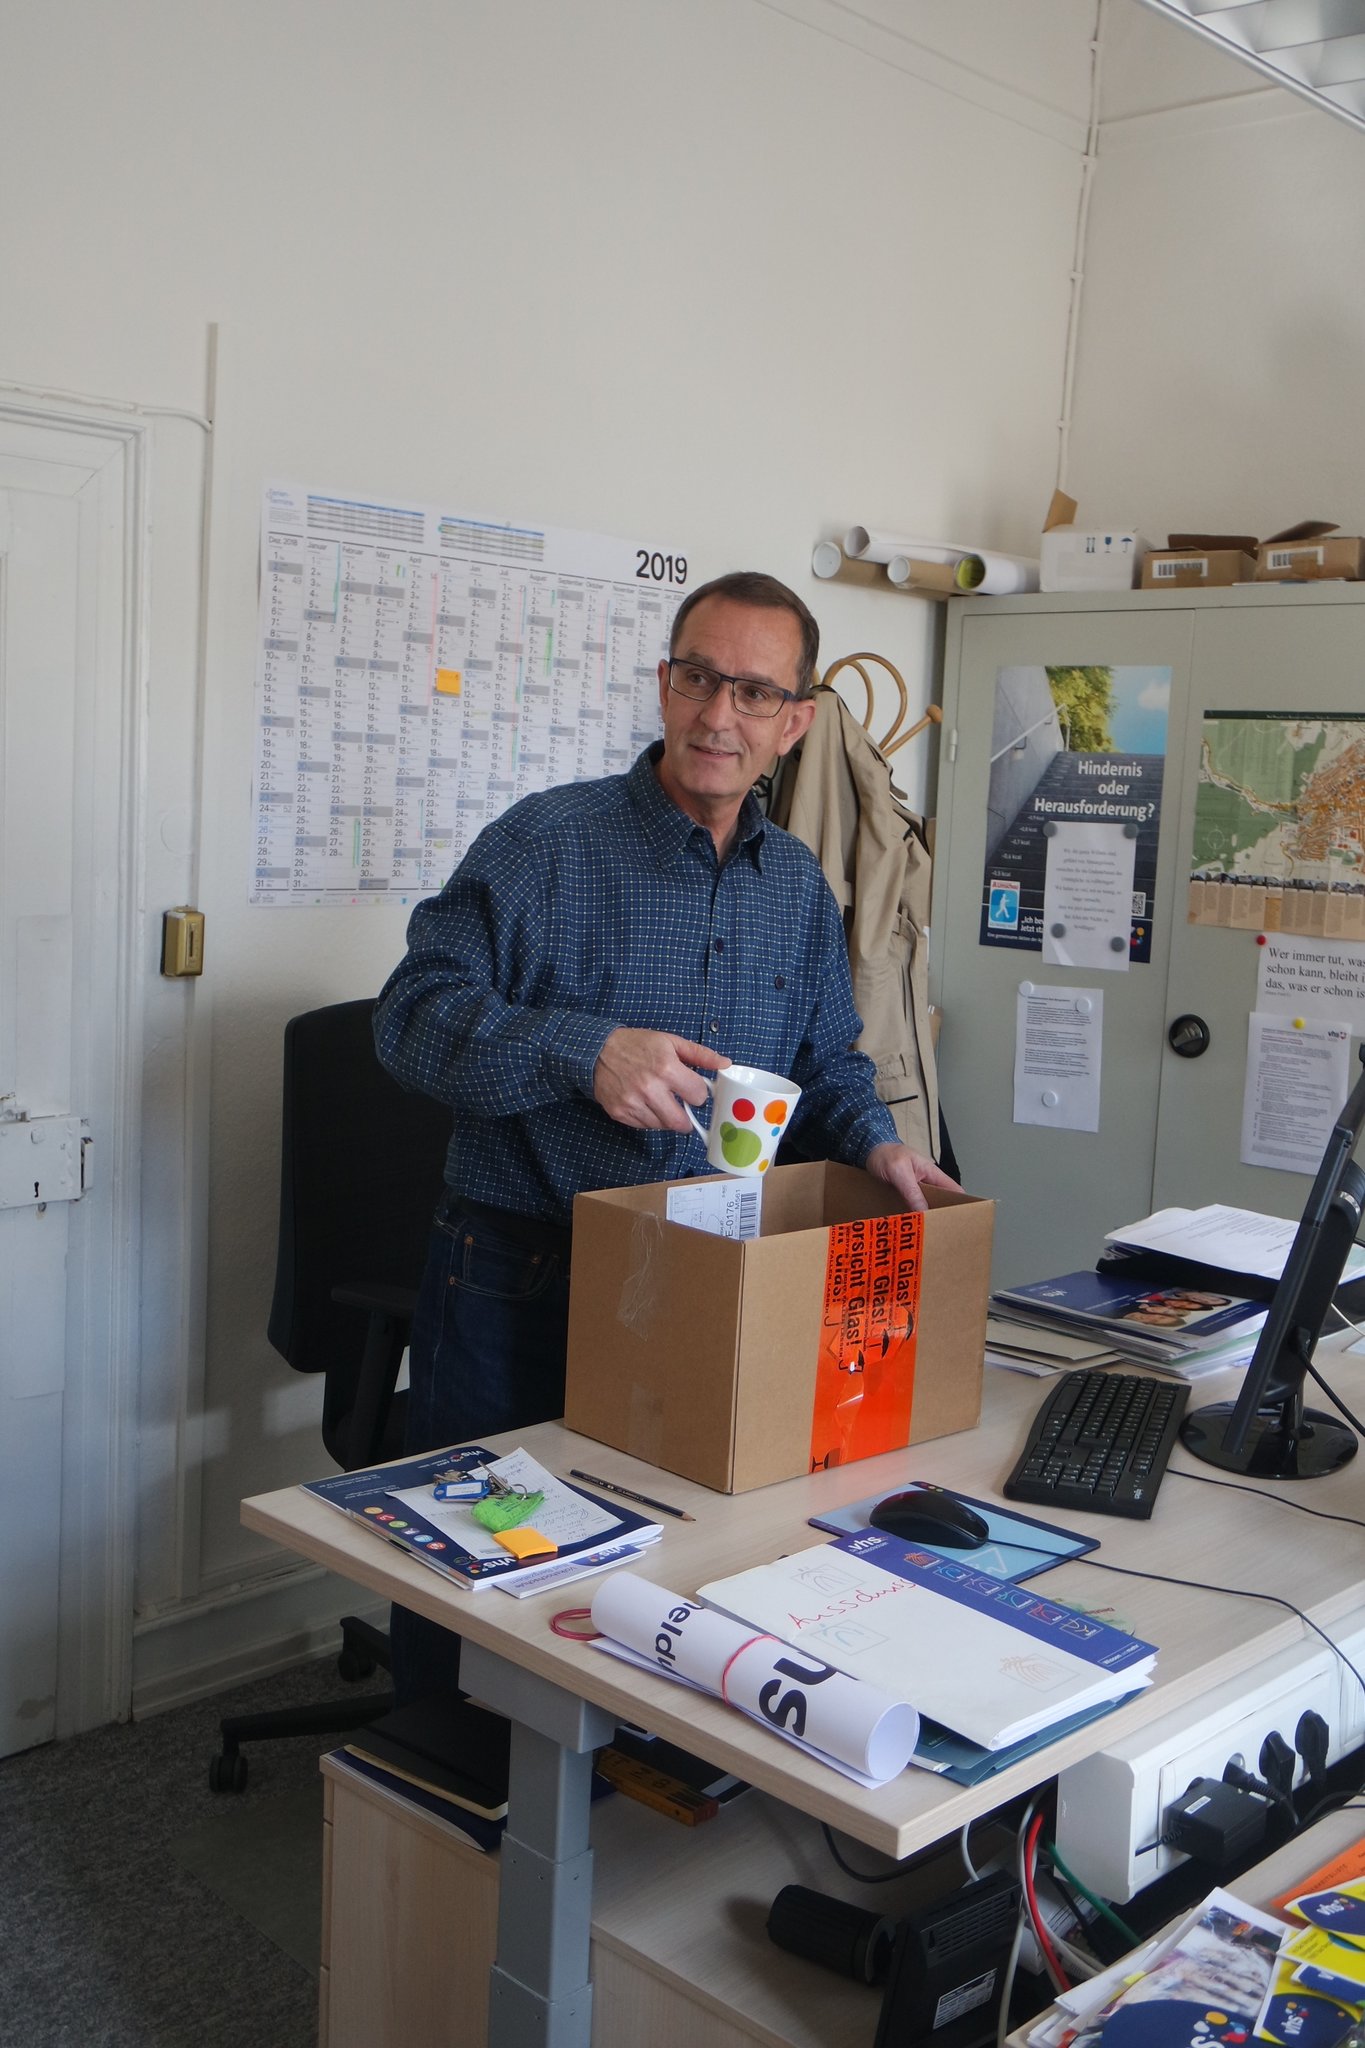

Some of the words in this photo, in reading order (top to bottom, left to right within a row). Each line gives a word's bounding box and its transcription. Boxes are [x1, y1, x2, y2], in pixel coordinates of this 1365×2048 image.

[636, 549, 688, 585] 2019
[266, 651, 275, 659] 10
[302, 654, 310, 662] 10
[265, 662, 271, 670] 11
[264, 673, 272, 681] 12
[301, 676, 308, 684] 12
[264, 684, 272, 692] 13
[264, 706, 271, 714] 15
[263, 728, 271, 736] 17
[300, 730, 307, 738] 17
[263, 739, 271, 747] 18
[300, 741, 307, 749] 18
[262, 750, 271, 758] 19
[299, 752, 307, 760] 19
[260, 760, 271, 769] 20
[1078, 760, 1142, 776] Hindernis
[260, 771, 269, 779] 21
[298, 773, 305, 781] 21
[260, 782, 270, 790] 22
[297, 784, 306, 792] 22
[1098, 780, 1130, 795] oder
[297, 794, 306, 802] 23
[259, 804, 269, 812] 24
[1034, 798, 1155, 822] Herausforderung?
[296, 816, 306, 824] 25
[258, 836, 268, 844] 27
[257, 847, 267, 855] 28
[257, 858, 267, 866] 29
[294, 858, 304, 866] 29
[294, 869, 303, 877] 30
[1269, 947, 1290, 959] Wer
[1292, 949, 1326, 963] immer
[1328, 955, 1344, 966] tut,
[1347, 958, 1365, 967] was
[1267, 964, 1296, 975] schon
[1299, 966, 1326, 979] kann,
[1329, 969, 1358, 982] bleibt
[1265, 978, 1285, 990] das,
[1288, 983, 1308, 992] was
[1323, 985, 1353, 997] schon
[1328, 1030, 1339, 1039] vhs
[875, 1217, 892, 1268] sicht
[850, 1221, 868, 1288] orsicht
[895, 1259, 914, 1308] Glas!
[871, 1276, 891, 1325] Glas!
[846, 1296, 866, 1346] Glas!
[466, 1449, 485, 1459] vhs
[848, 1536, 882, 1551] vhs
[483, 1557, 516, 1570] vhs
[1316, 1900, 1344, 1916] vhs
[1281, 2014, 1305, 2036] vhs
